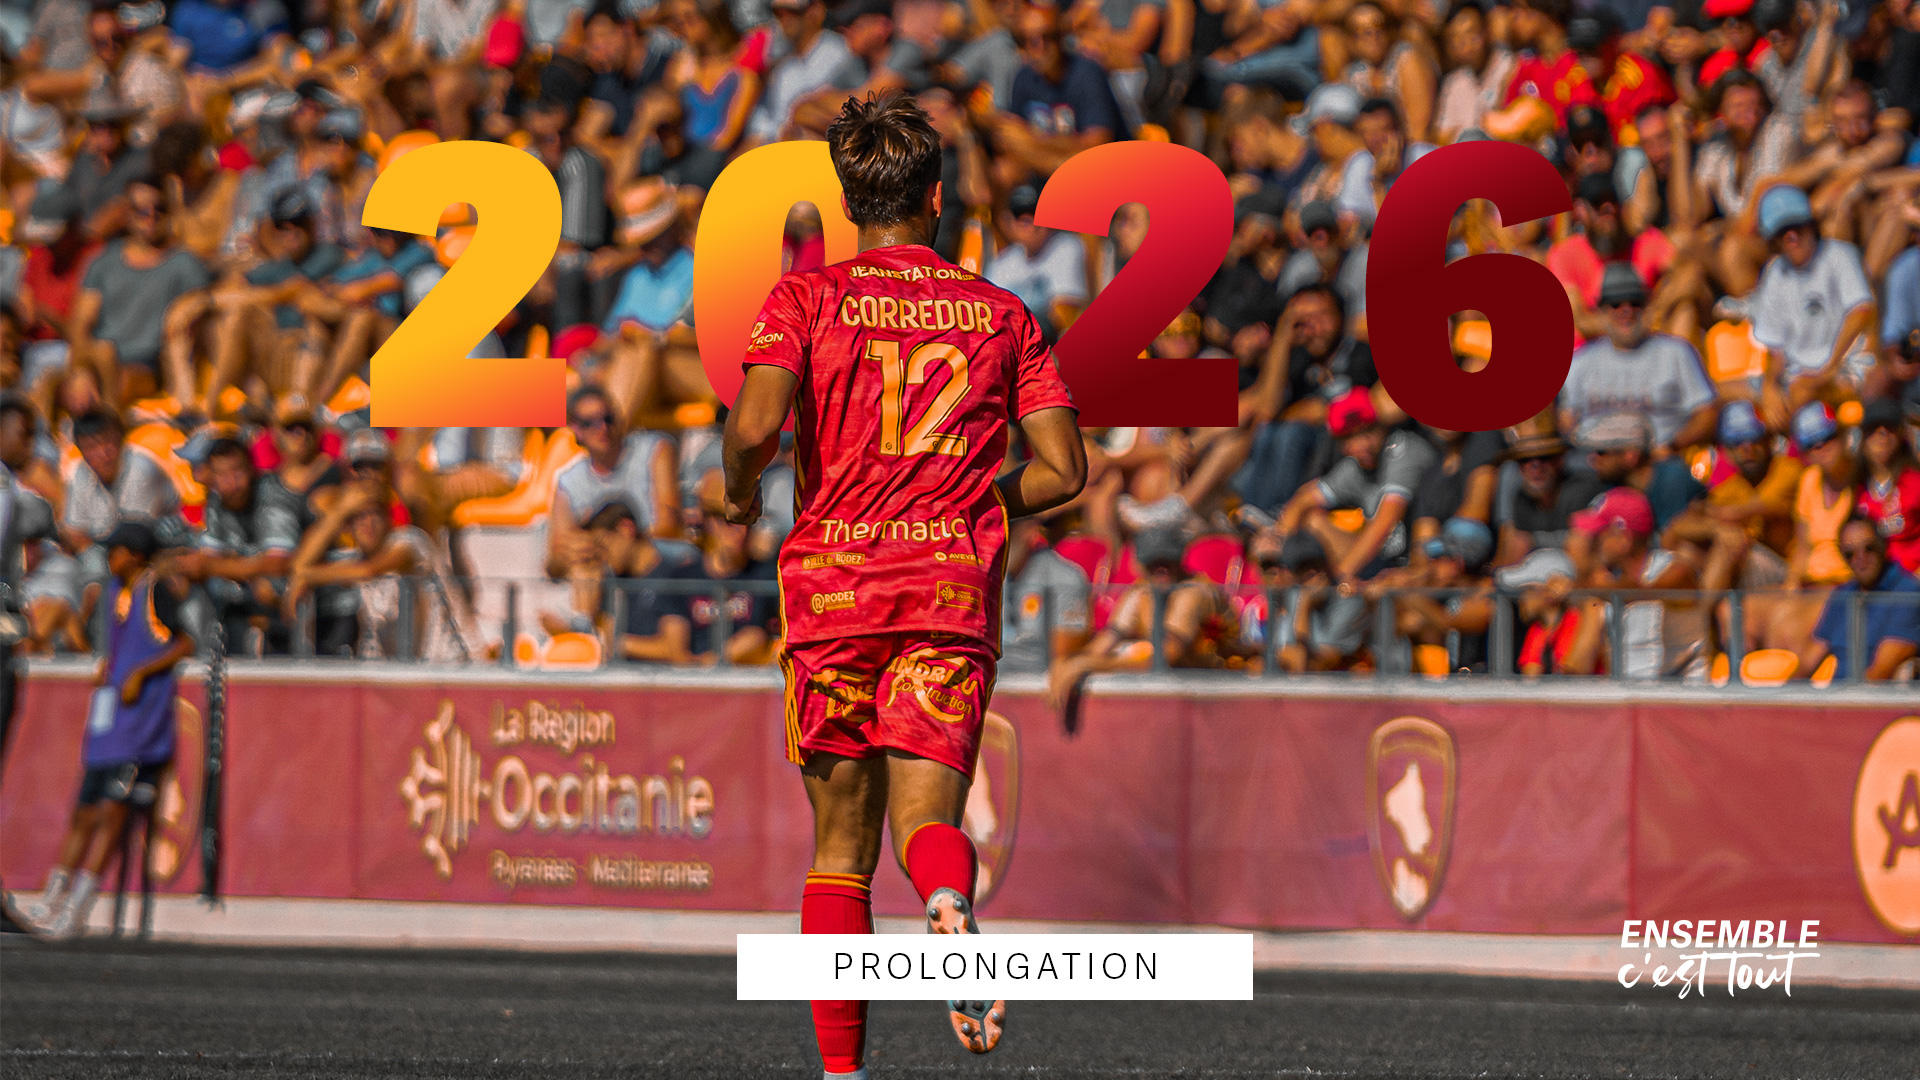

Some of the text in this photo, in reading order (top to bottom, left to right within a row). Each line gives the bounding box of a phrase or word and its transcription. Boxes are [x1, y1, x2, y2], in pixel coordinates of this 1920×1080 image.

[841, 295, 996, 334] CORREDOR
[864, 339, 973, 457] 12
[819, 516, 968, 544] Thermatic
[835, 553, 862, 564] RODEZ
[824, 590, 855, 602] RODEZ
[492, 699, 525, 745] La
[492, 753, 714, 838] Occitanie
